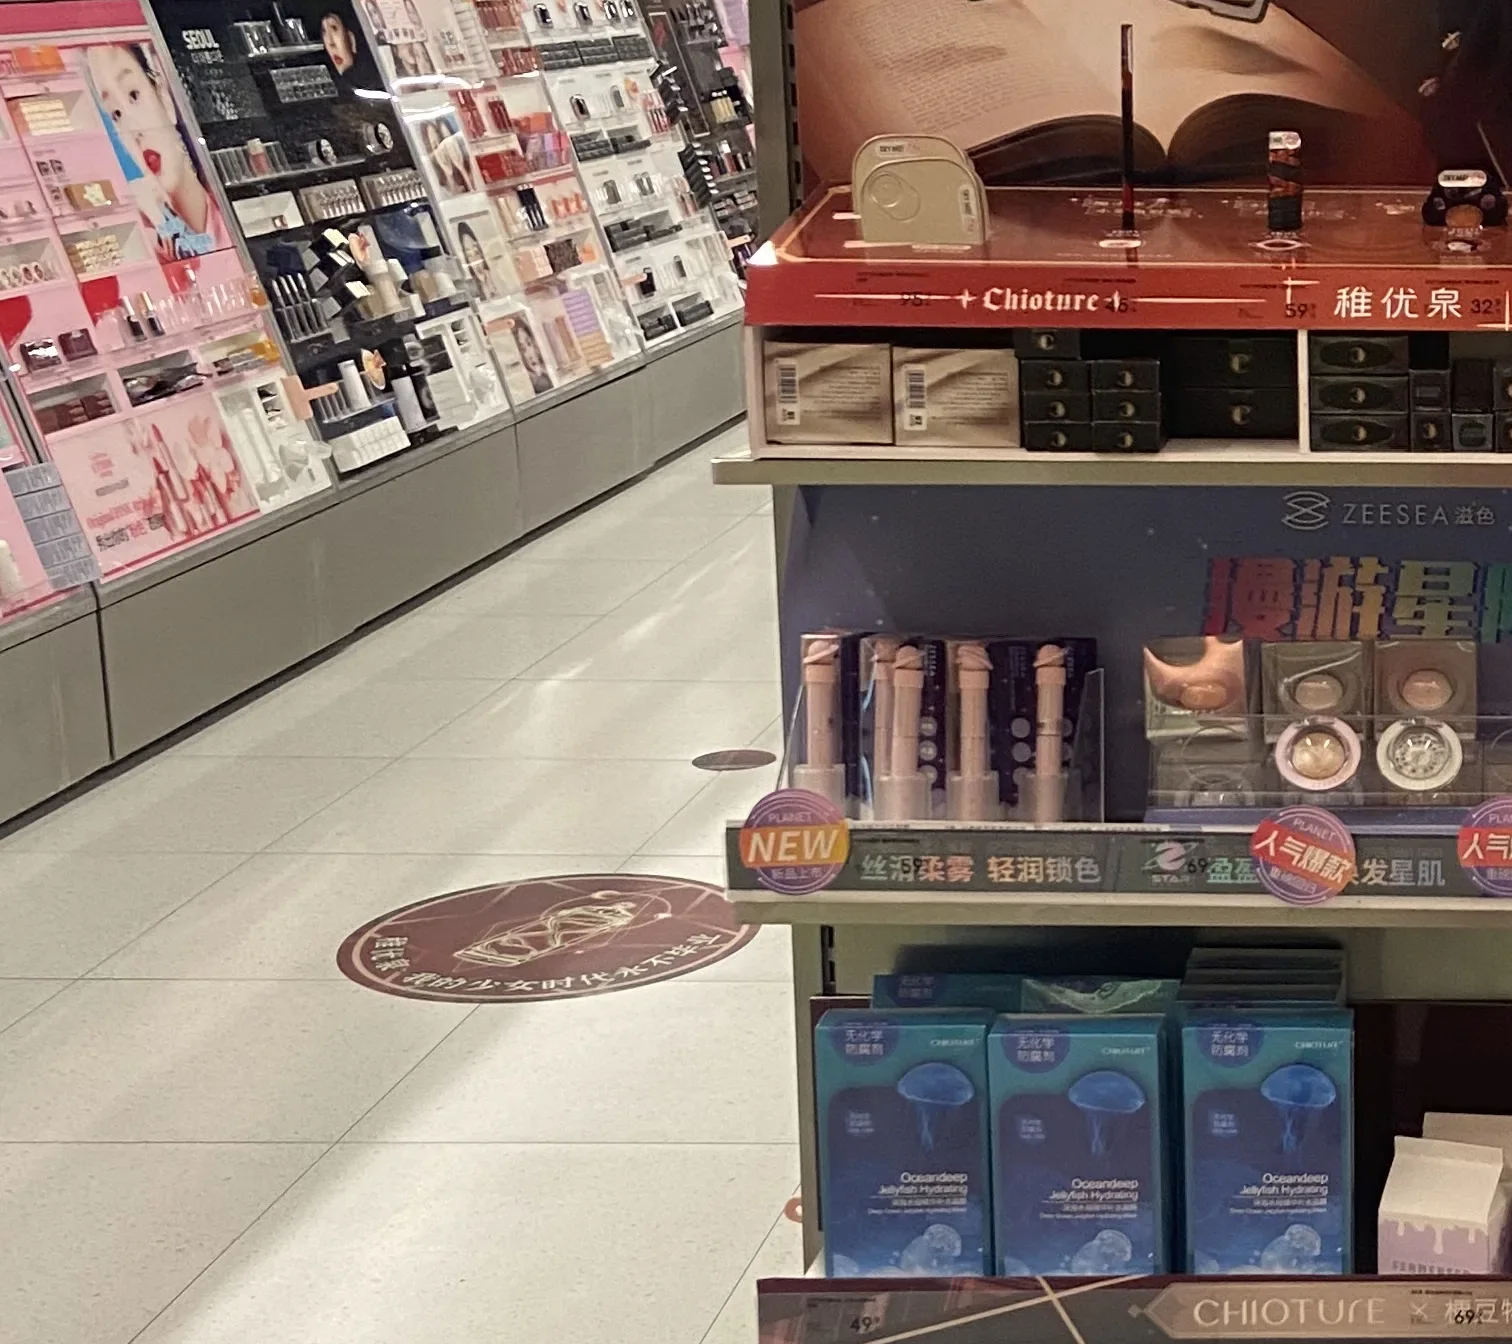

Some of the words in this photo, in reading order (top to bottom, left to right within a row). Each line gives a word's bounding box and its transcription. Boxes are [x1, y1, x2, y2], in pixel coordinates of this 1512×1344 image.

[182, 28, 220, 50] SEOUL
[982, 286, 1100, 312] Chioture
[1333, 286, 1462, 320] 稚优泉
[1470, 298, 1493, 315] 32
[1342, 503, 1449, 526] ZEESEA
[1454, 503, 1496, 526] 滋色
[768, 812, 813, 823] PLANET
[1292, 817, 1336, 841] PLANET
[748, 828, 840, 863] NEW
[1254, 828, 1351, 884] 人气爆款
[987, 855, 1101, 884] 轻润锁色
[1186, 857, 1208, 874] 69
[844, 1029, 884, 1043] 无化学
[1017, 1036, 1056, 1049] 无化学
[1211, 1030, 1249, 1043] 无化学
[901, 1172, 968, 1184] Oceandeep
[1072, 1177, 1139, 1189] Oceandeep
[1262, 1172, 1329, 1184] Oceandeep
[919, 1185, 968, 1197] Hydrating
[1090, 1189, 1139, 1202] Hydrating
[1281, 1184, 1329, 1197] Hydrating
[1193, 1297, 1387, 1328] CHIOTURE
[1454, 1308, 1476, 1325] 69
[850, 1315, 873, 1334] 49
